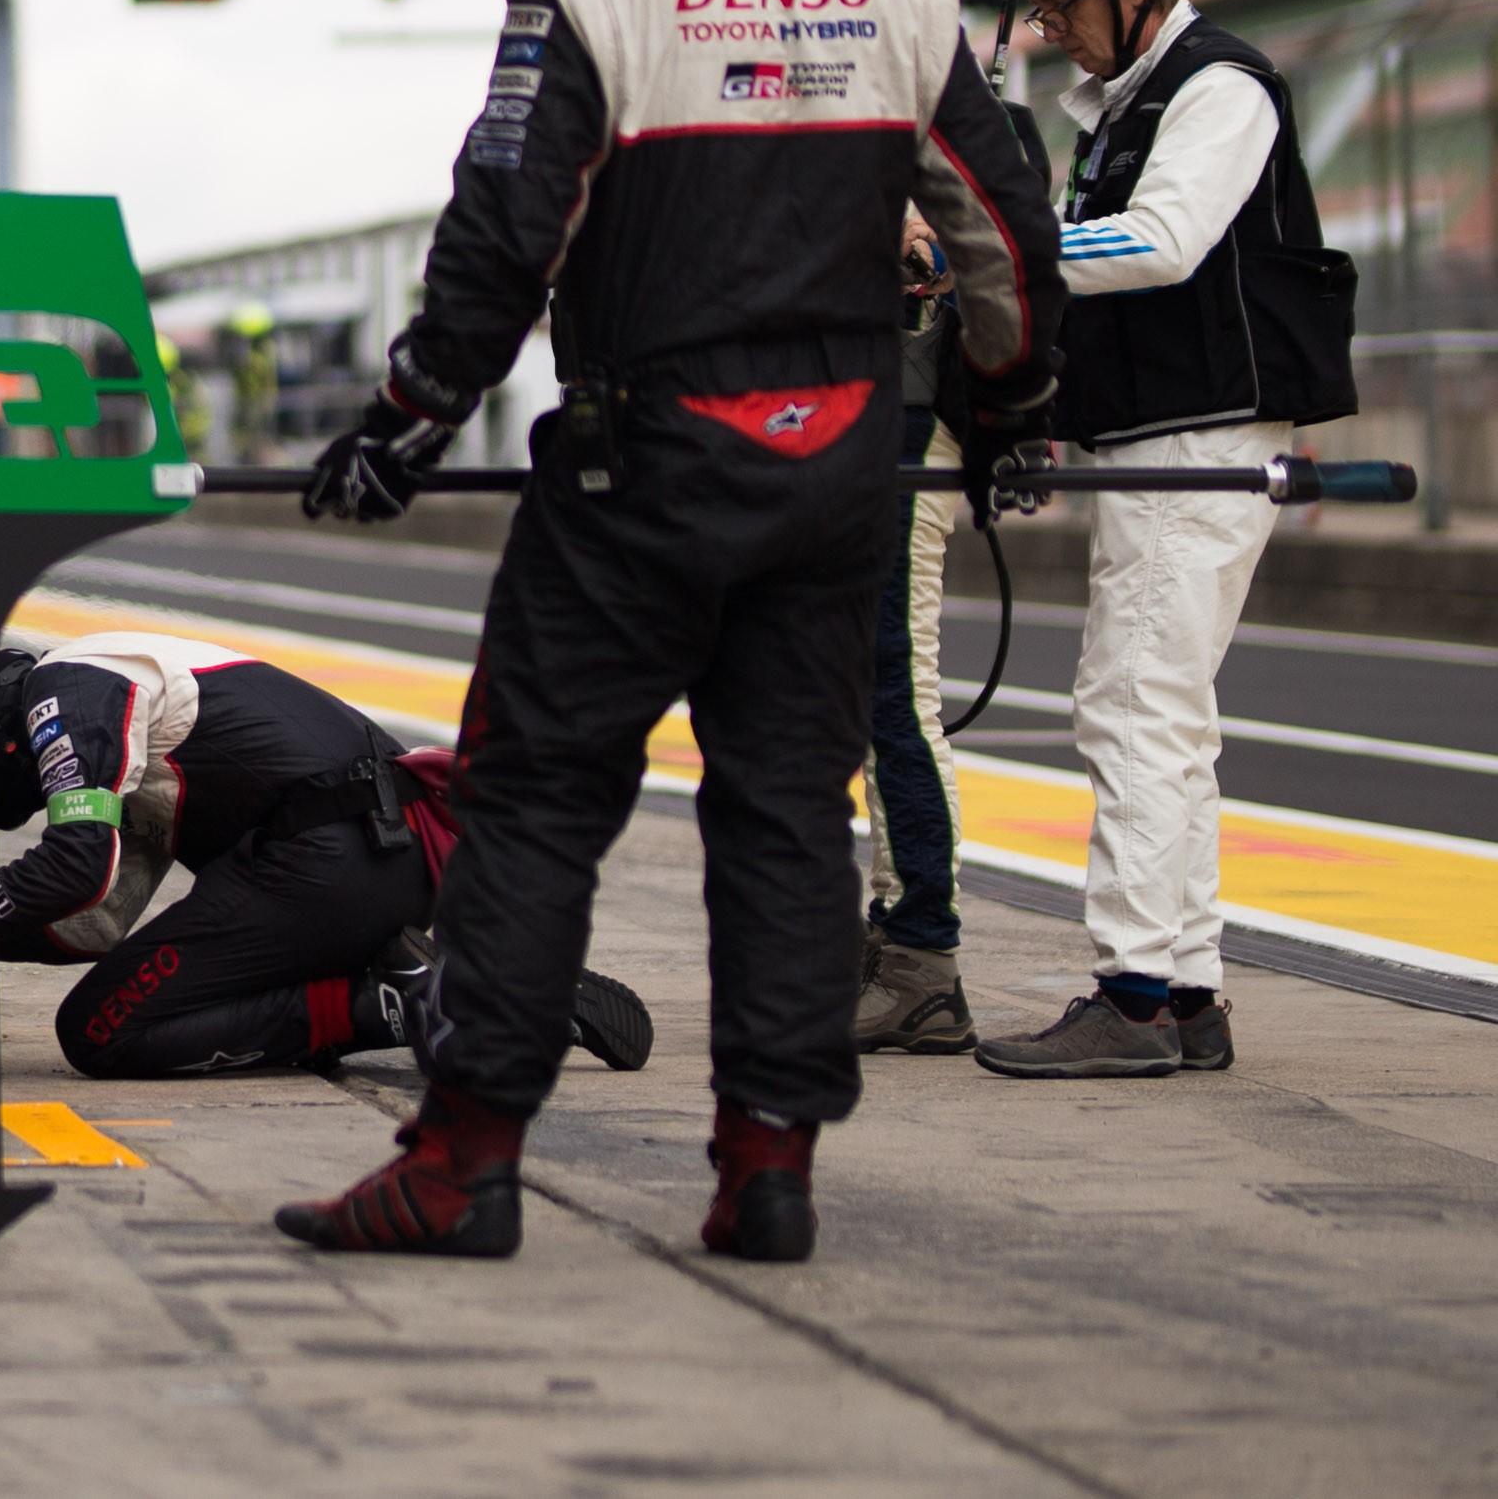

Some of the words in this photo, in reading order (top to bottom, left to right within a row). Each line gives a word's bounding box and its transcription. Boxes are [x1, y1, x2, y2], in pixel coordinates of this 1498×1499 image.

[677, 22, 776, 43] TOYOTA
[779, 19, 877, 41] HYBRID
[721, 73, 783, 100] GR
[59, 805, 94, 818] LANE
[65, 794, 87, 805] PIT
[85, 944, 180, 1047] DENSO
